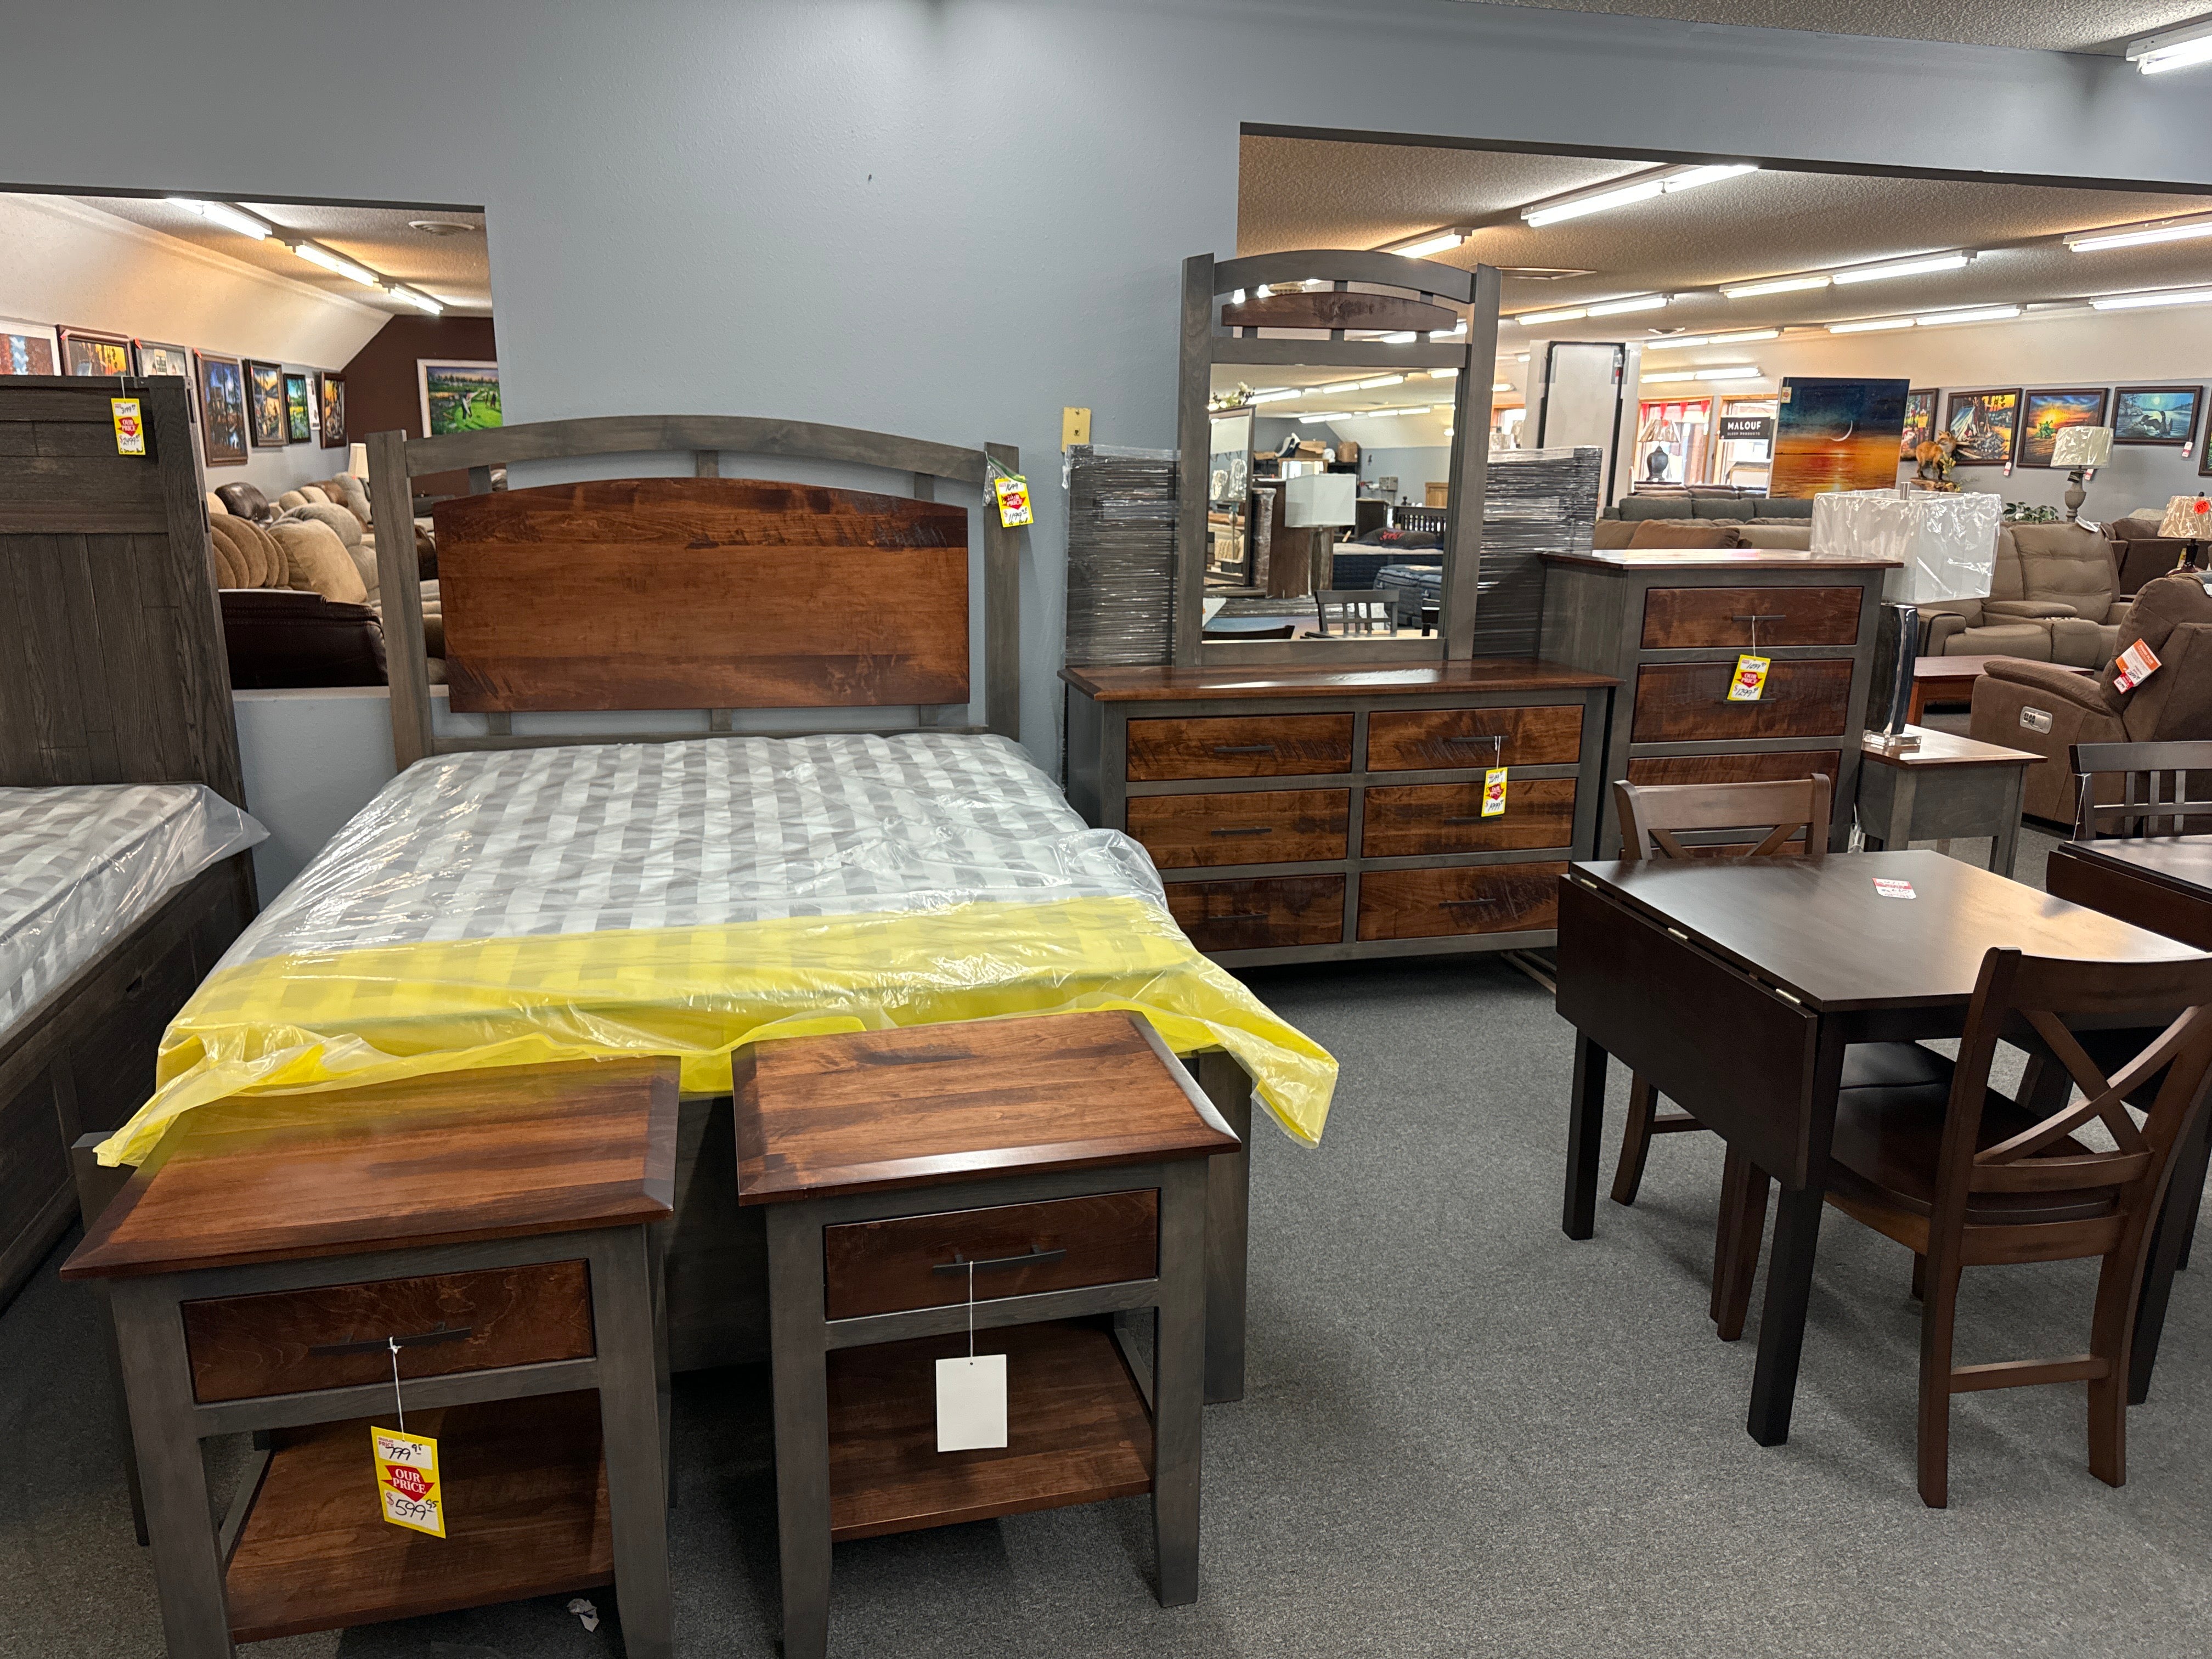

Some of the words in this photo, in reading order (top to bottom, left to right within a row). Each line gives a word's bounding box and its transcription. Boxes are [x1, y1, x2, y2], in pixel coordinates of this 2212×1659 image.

[1727, 421, 1762, 430] MALOUF
[395, 1469, 421, 1483] OUR
[393, 1477, 426, 1494] PRICE
